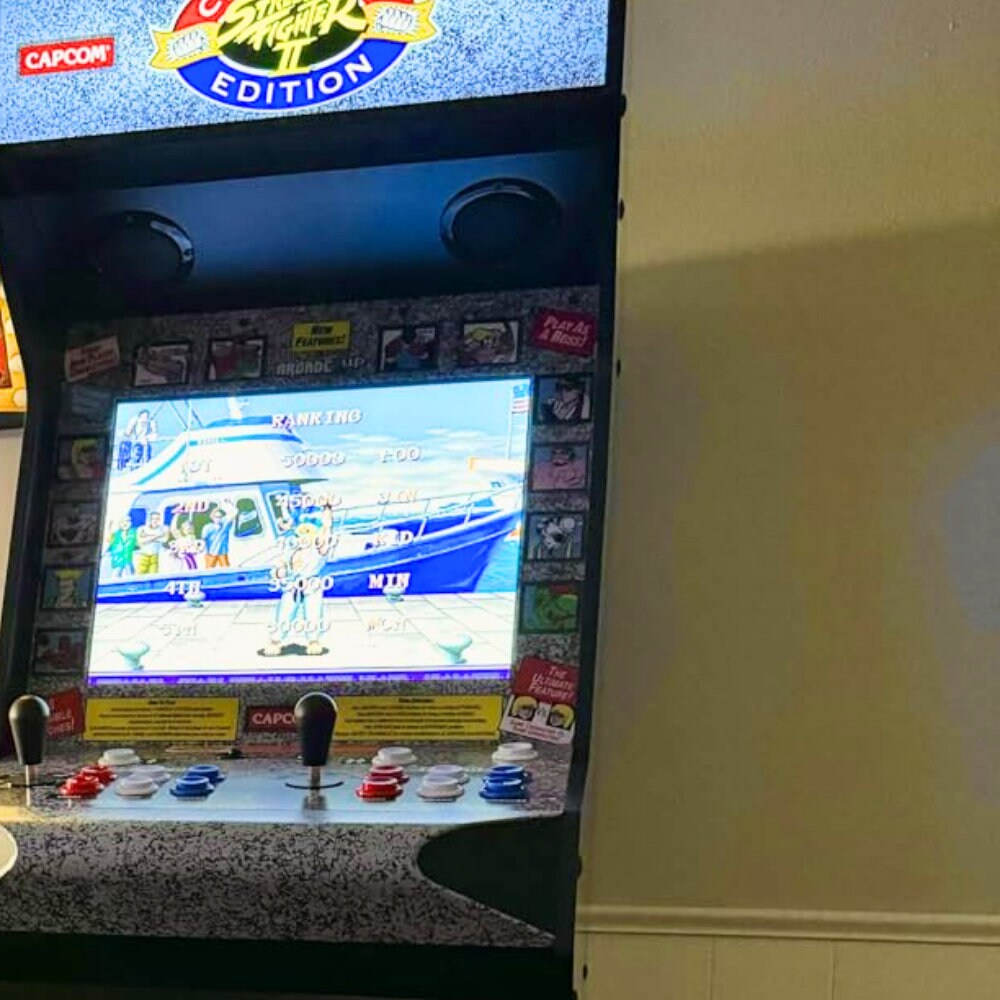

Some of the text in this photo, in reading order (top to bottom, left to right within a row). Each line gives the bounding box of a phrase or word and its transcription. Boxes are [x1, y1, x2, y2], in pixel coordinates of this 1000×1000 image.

[24, 45, 108, 70] CAPCOM
[210, 53, 374, 105] EDITION
[271, 408, 363, 430] RANKING
[164, 580, 202, 597] 4TH
[367, 572, 411, 590] MIN
[252, 711, 296, 726] CAPC
